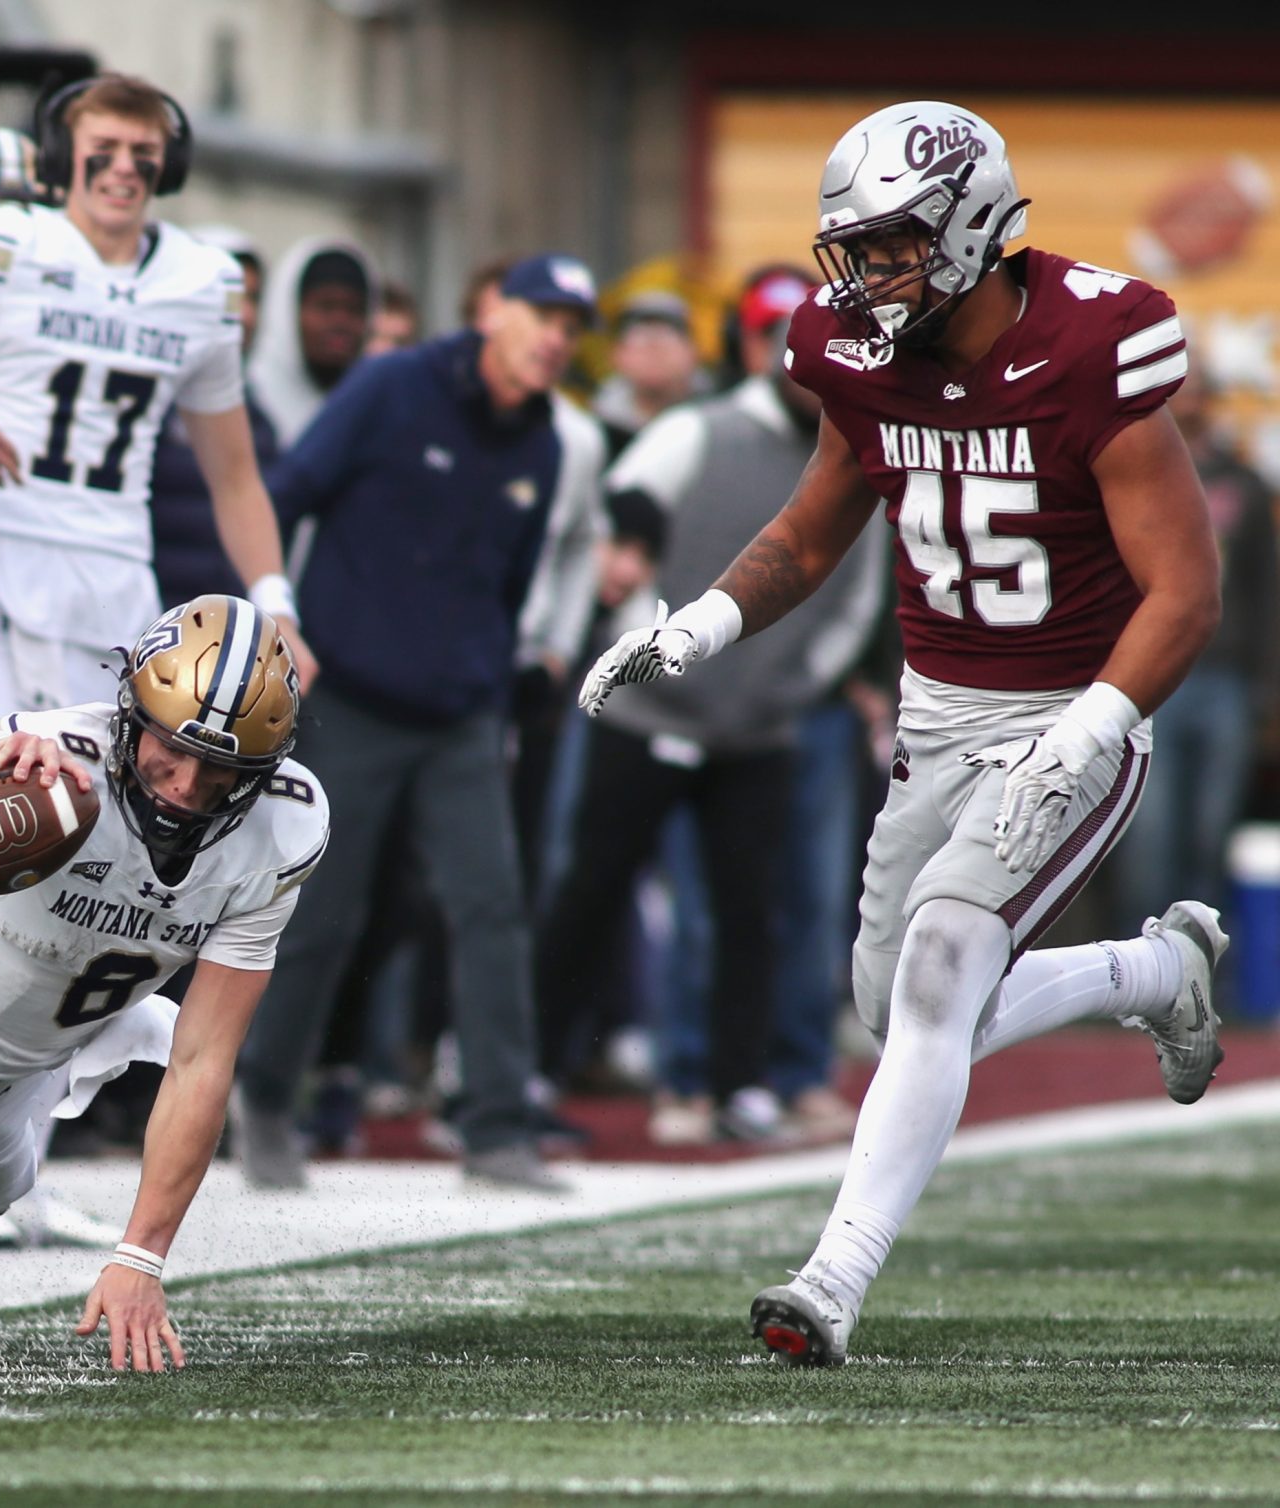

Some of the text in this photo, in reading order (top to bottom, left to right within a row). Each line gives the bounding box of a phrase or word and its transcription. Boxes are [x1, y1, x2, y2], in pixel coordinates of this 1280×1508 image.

[904, 120, 988, 172] Griz
[37, 306, 189, 367] MONTANA STATE
[943, 383, 967, 399] Griz
[30, 358, 158, 493] 17
[878, 422, 1037, 474] MONTANA
[897, 469, 1053, 627] 45
[58, 730, 103, 766] 8
[263, 773, 317, 809] 8
[85, 863, 109, 877] SKY
[49, 889, 218, 947] MONTANA STAT
[53, 946, 161, 1029] 8
